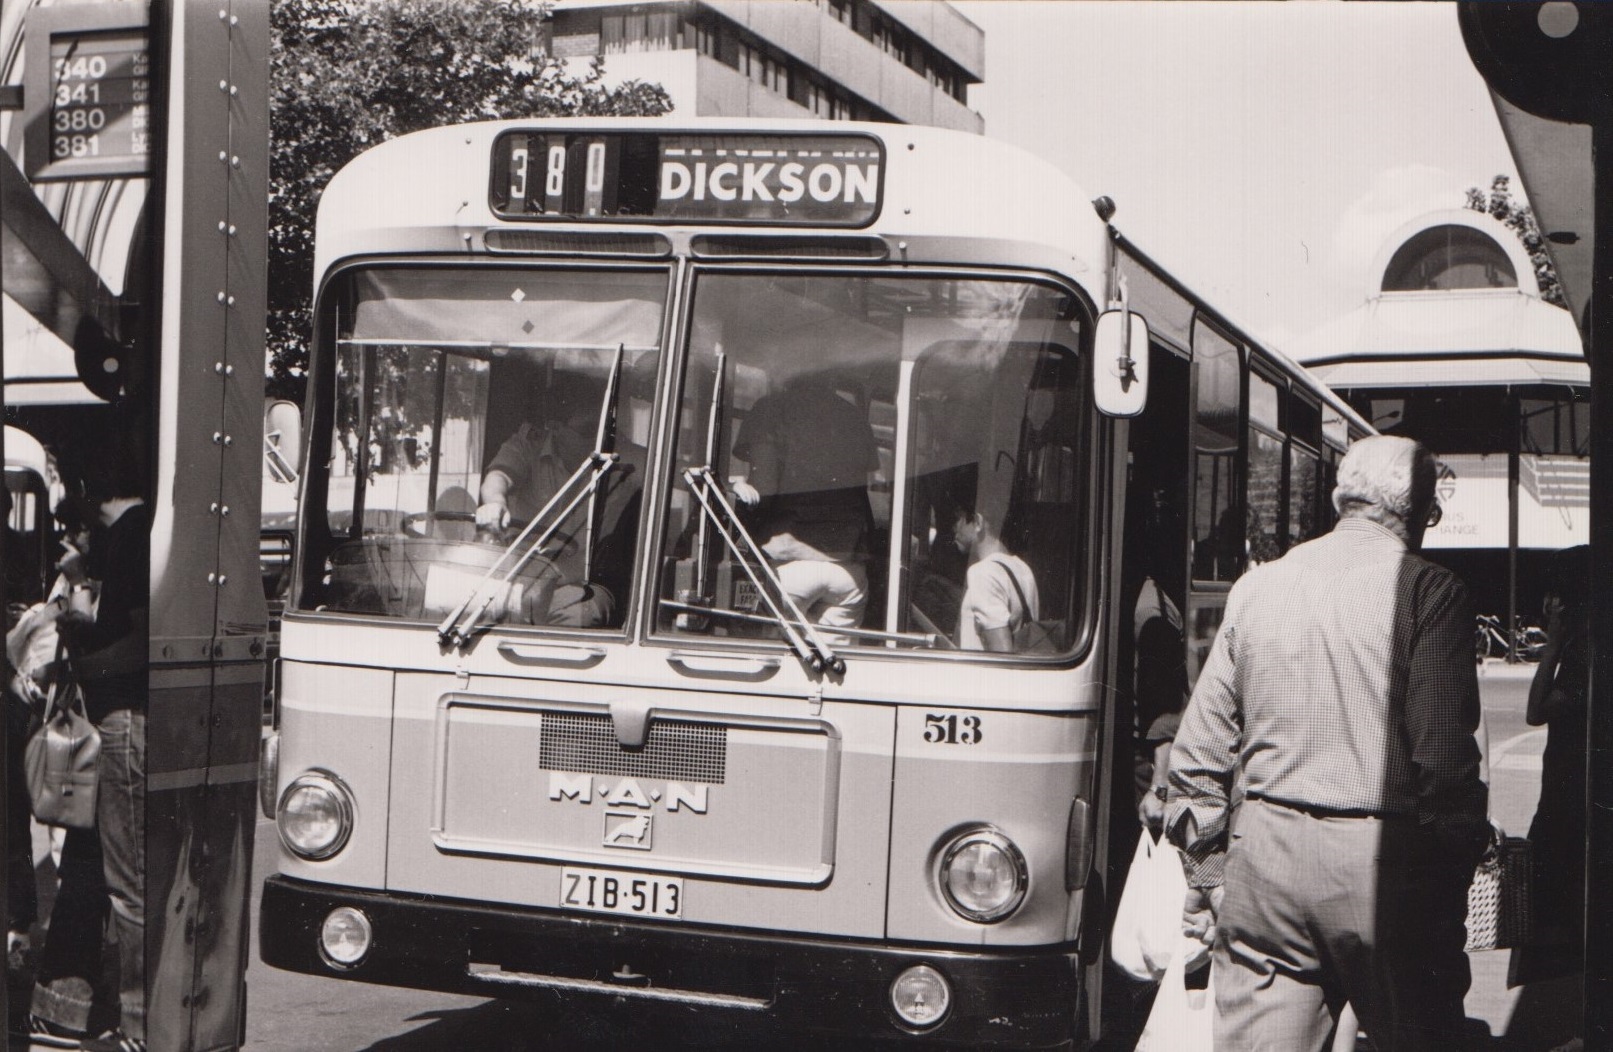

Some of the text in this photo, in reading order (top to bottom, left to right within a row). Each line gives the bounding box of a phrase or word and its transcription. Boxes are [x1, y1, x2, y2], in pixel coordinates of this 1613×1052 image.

[54, 55, 107, 81] 340
[55, 83, 101, 106] 341
[54, 108, 105, 132] 380
[54, 134, 99, 157] 381
[660, 161, 879, 203] DICKSON
[923, 713, 983, 745] 513
